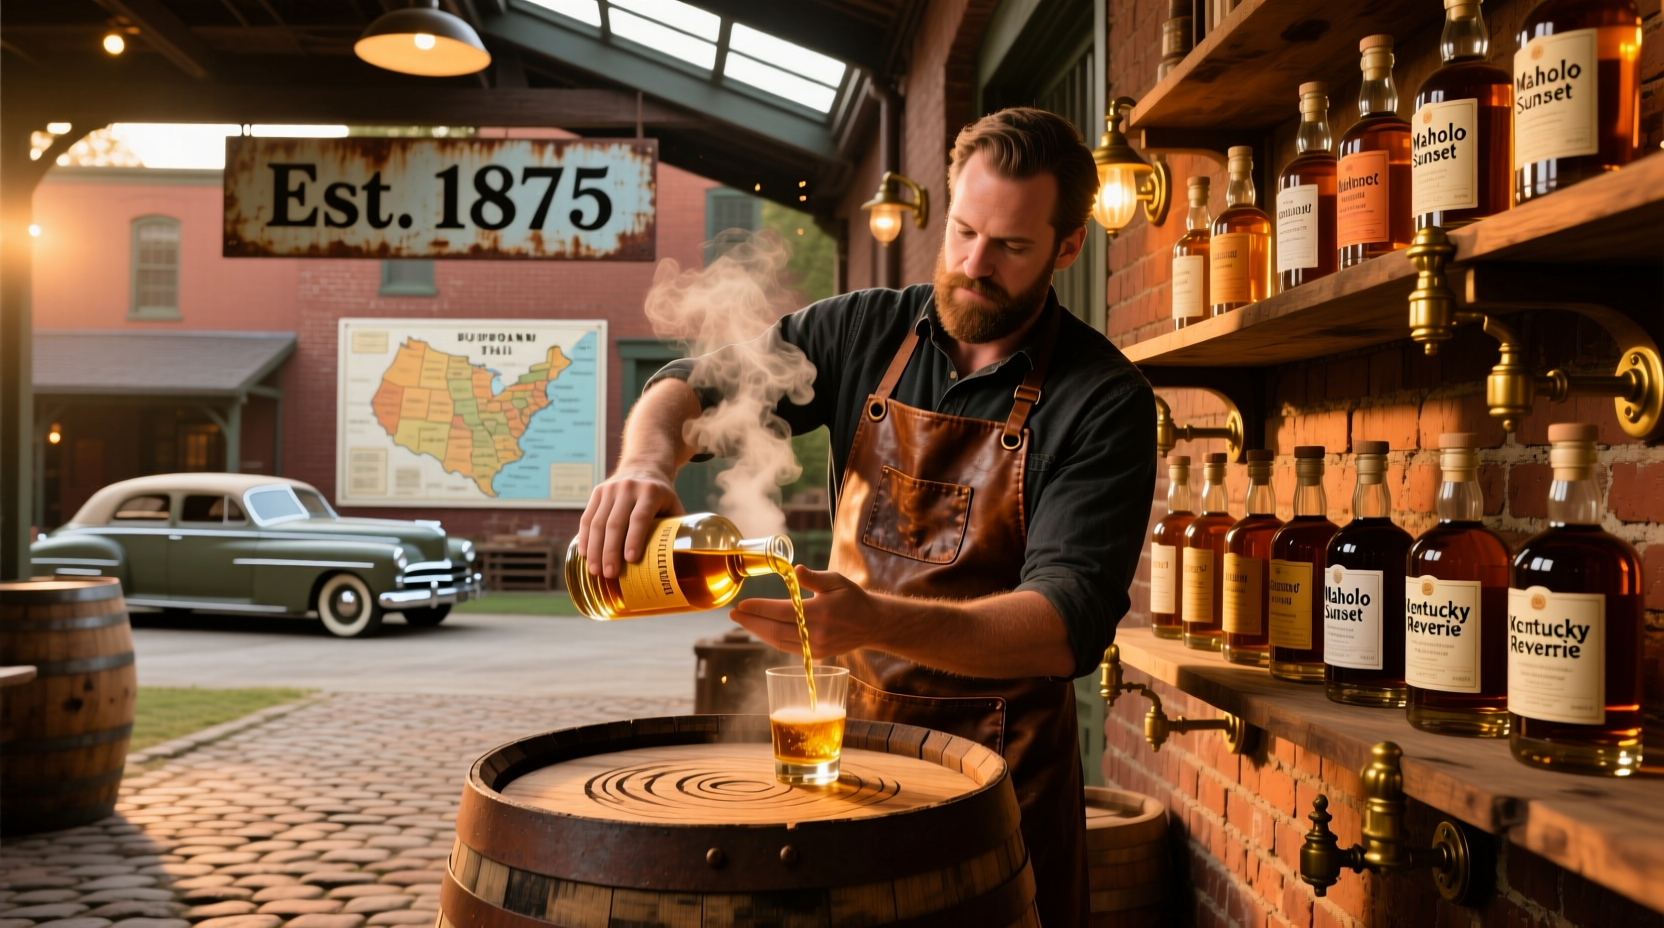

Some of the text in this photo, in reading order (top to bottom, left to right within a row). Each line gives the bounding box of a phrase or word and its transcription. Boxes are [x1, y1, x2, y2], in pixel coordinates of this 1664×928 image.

[1516, 59, 1581, 93] Maholo
[1516, 83, 1573, 115] Sunset
[1413, 143, 1457, 168] Sunset
[266, 163, 613, 231] Est. 1875
[1325, 604, 1363, 622] Sunset
[1407, 616, 1462, 637] Reverie
[1511, 635, 1581, 659] Reverrie
